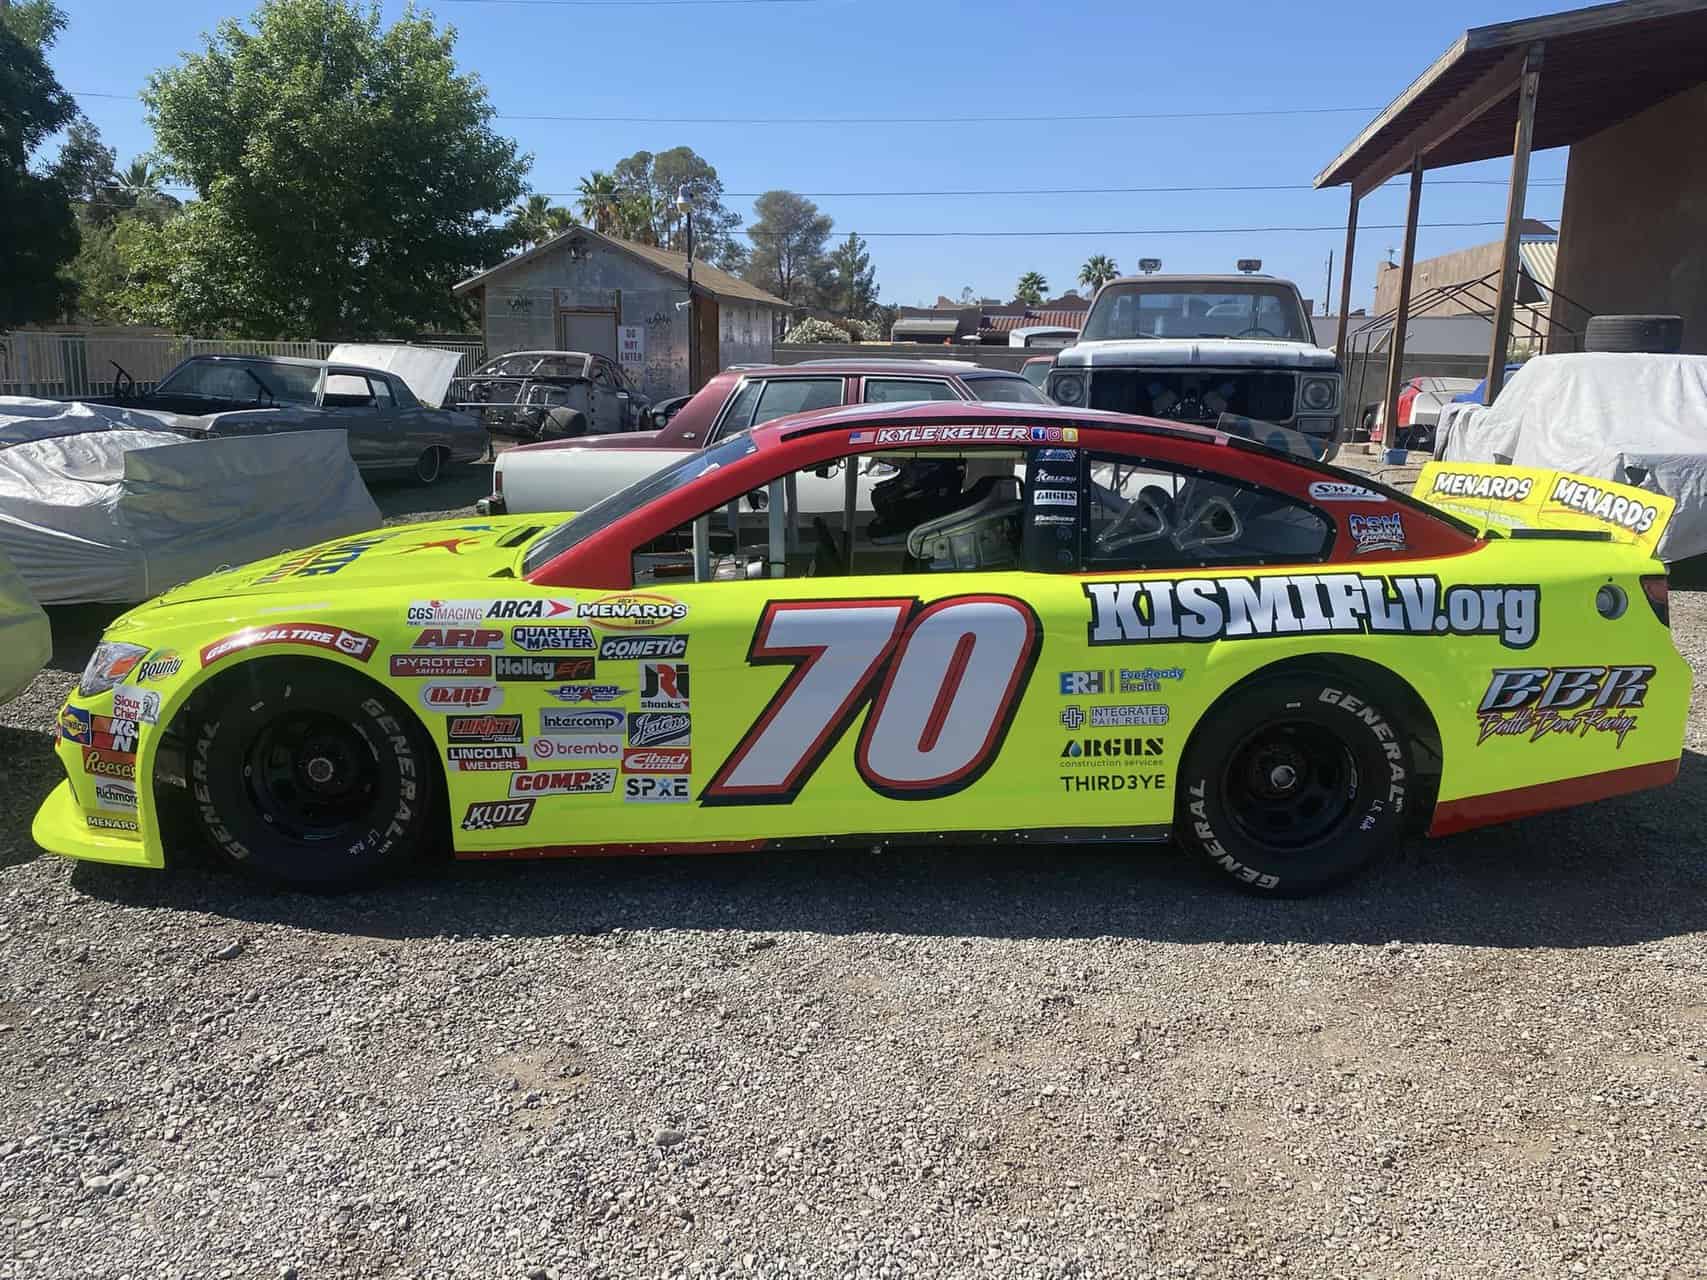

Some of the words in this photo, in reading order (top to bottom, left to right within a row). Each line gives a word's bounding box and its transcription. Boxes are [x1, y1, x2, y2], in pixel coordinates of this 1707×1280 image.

[878, 427, 937, 443] KYLE
[940, 425, 1029, 441] KELLER
[1434, 472, 1532, 500] MENARDS
[1552, 477, 1656, 535] MENARDS
[486, 600, 543, 618] ARCA
[577, 602, 687, 619] MENARDS
[290, 629, 334, 643] TIRE
[411, 629, 504, 648] ARP
[513, 628, 589, 641] QUARTER
[527, 637, 593, 649] MASTER
[601, 636, 687, 656] COMETIC
[136, 657, 184, 684] Bounty
[395, 657, 487, 668] PYROTECT
[497, 658, 555, 680] Holley
[1060, 670, 1104, 695] ERH
[1120, 668, 1184, 681] EverReady
[1120, 681, 1162, 693] Health
[1478, 665, 1657, 712] BBR
[114, 694, 140, 710] Sioux
[641, 700, 681, 710] shocks
[697, 593, 1044, 807] 70
[113, 706, 138, 721] Chief
[1091, 705, 1169, 718] INTEGRATED
[1091, 716, 1119, 727] PAIN
[1122, 714, 1169, 725] RELIEF
[544, 715, 615, 729] Intercomp
[630, 713, 690, 746] Jostens
[557, 743, 619, 755] brembo
[1060, 737, 1164, 758] ARGUS
[1318, 686, 1406, 803] GENERAL
[450, 748, 513, 760] LINCOLN
[624, 752, 689, 770] Eibach
[1060, 758, 1121, 768] construction
[1123, 758, 1163, 767] services
[361, 698, 417, 837] GENERAL
[465, 760, 521, 770] WELDERS
[193, 720, 250, 860] GENERAL
[515, 771, 592, 791] COMP
[1060, 774, 1166, 793] THIRD3YE
[470, 803, 530, 824] KLOTZ
[88, 815, 139, 831] MENARD
[1189, 779, 1281, 890] GENERAL
